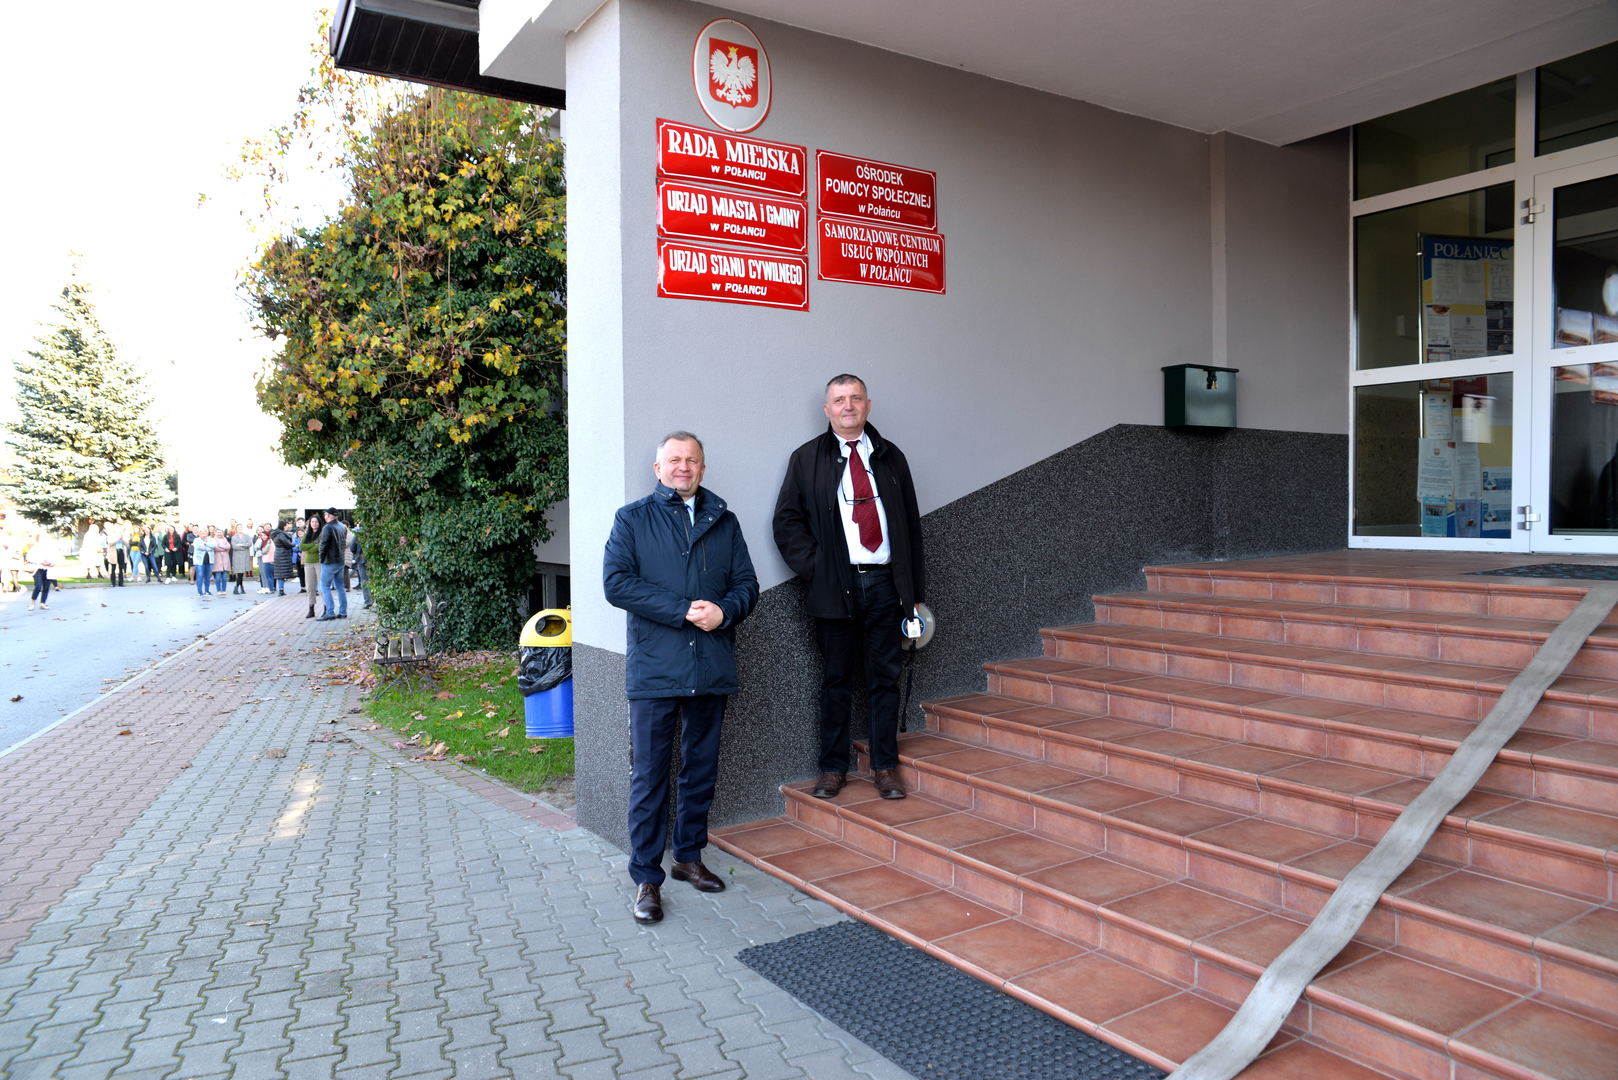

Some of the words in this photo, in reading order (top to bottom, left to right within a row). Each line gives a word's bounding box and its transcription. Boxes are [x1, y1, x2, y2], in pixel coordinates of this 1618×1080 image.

[667, 128, 719, 160] RADA
[724, 139, 800, 176] MIEJSKA
[856, 164, 904, 186] OŚRODEK
[825, 178, 870, 198] POMOCY
[871, 185, 931, 209] SPOŁECZNEJ
[667, 190, 707, 216] URZĄD
[711, 196, 757, 222] MIASTA
[766, 205, 800, 229] GMINY
[867, 203, 900, 219] Połańcu
[825, 223, 899, 247] SAMORZĄDOWE
[900, 233, 940, 253] CENTRUM
[669, 249, 707, 275] URZĄD
[710, 254, 745, 278] STANU
[748, 259, 803, 286] CYWILNEGO
[841, 242, 873, 261] USŁUG
[875, 246, 929, 269] WSPÓLNYCH
[859, 263, 868, 278] W
[869, 264, 913, 284] POŁAŃCU
